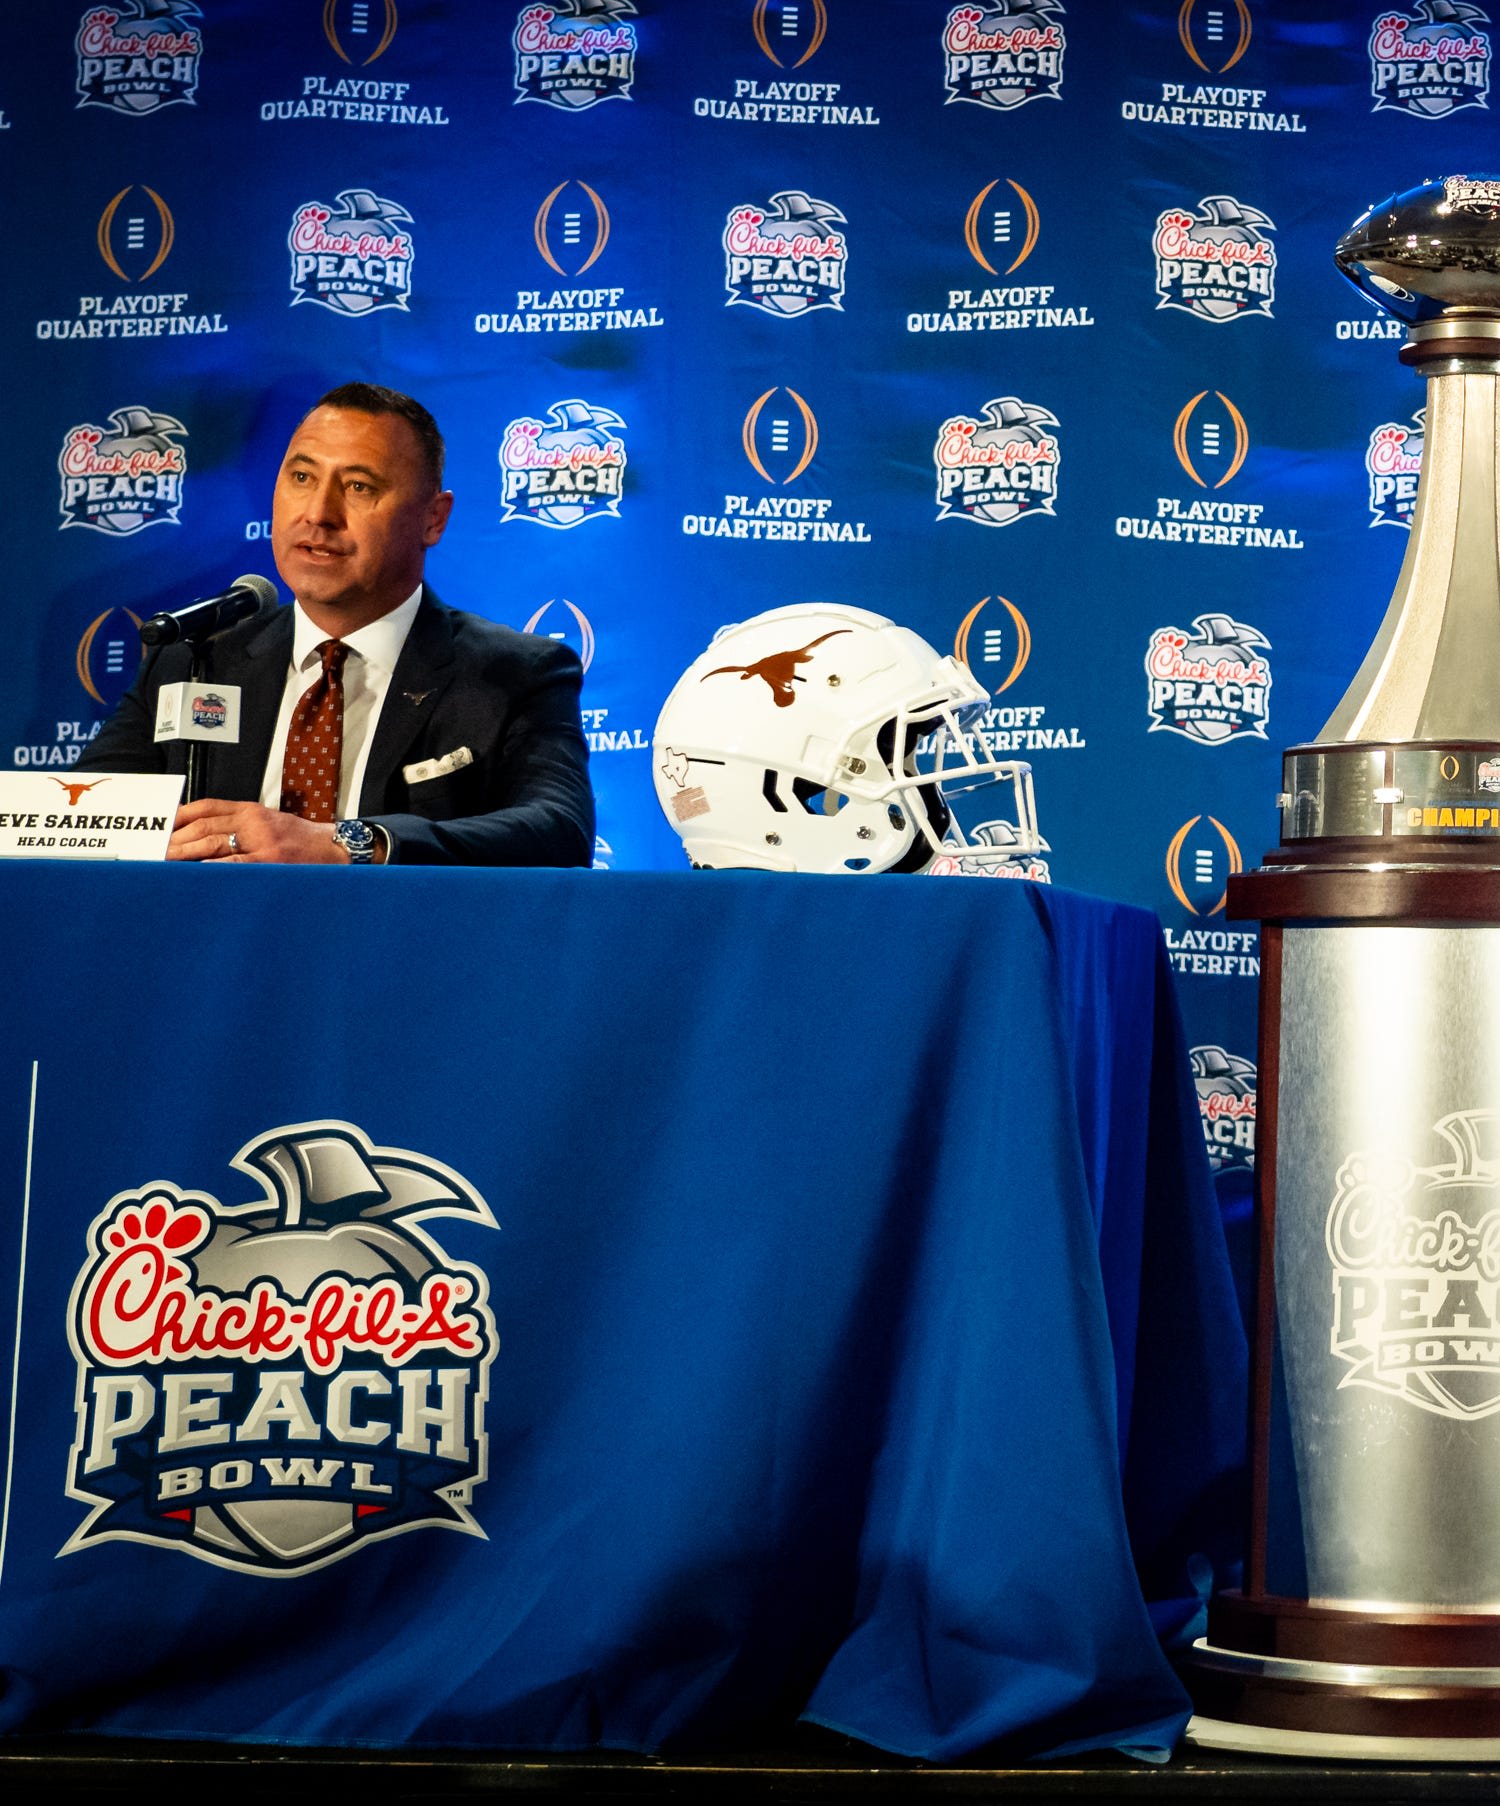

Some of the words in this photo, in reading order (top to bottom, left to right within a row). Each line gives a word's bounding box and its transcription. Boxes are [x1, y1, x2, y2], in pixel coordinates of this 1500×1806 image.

[82, 23, 195, 57] Chick-fil-A
[519, 20, 630, 53] Chick-fil-A
[949, 20, 1058, 52] Chick-fil-A
[1375, 28, 1484, 62] Chick-fil-A
[82, 57, 195, 86] PEACH
[520, 53, 630, 82] PEACH
[950, 51, 1058, 82] PEACH
[1377, 61, 1485, 90] PEACH
[103, 82, 171, 94] BOWL
[303, 77, 410, 101] PLAYOFF
[541, 79, 607, 90] BOWL
[735, 80, 840, 102] PLAYOFF
[971, 78, 1036, 89] BOWL
[1162, 84, 1266, 108] PLAYOFF
[1398, 87, 1463, 97] BOWL
[261, 97, 449, 126] QUARTERFINAL
[694, 99, 879, 126] QUARTERFINAL
[1122, 102, 1306, 134] QUARTERFINAL
[295, 219, 407, 258] Chick-fil-A
[730, 222, 840, 260] Chick-fil-A
[1159, 225, 1269, 265] Chick-fil-A
[296, 254, 406, 289] PEACH
[731, 257, 840, 289] PEACH
[1161, 260, 1269, 295] PEACH
[317, 283, 384, 296] BOWL
[517, 289, 624, 310] PLAYOFF
[752, 284, 818, 296] BOWL
[948, 286, 1054, 308] PLAYOFF
[1182, 289, 1248, 302] BOWL
[79, 294, 188, 316] PLAYOFF
[37, 315, 228, 339] QUARTERFINAL
[476, 310, 664, 333] QUARTERFINAL
[907, 308, 1094, 332] QUARTERFINAL
[66, 442, 179, 476] Chick-fil-A
[507, 435, 618, 469] Chick-fil-A
[941, 433, 1052, 467] Chick-fil-A
[66, 475, 178, 506] PEACH
[507, 468, 618, 499] PEACH
[942, 465, 1052, 497] PEACH
[87, 502, 155, 514] BOWL
[528, 495, 595, 507] BOWL
[725, 496, 831, 519] PLAYOFF
[963, 493, 1030, 504] BOWL
[1157, 499, 1263, 524] PLAYOFF
[683, 516, 871, 543] QUARTERFINAL
[1116, 518, 1303, 550] QUARTERFINAL
[1152, 645, 1264, 685] Chick-fil-A
[1154, 681, 1264, 716] PEACH
[1175, 710, 1242, 723] BOWL
[0, 813, 39, 828] EVE
[44, 814, 167, 831] SARKISIAN
[17, 837, 56, 847] HEAD
[59, 838, 107, 848] COACH
[1163, 928, 1257, 952] LAYOFF
[90, 1243, 475, 1367] Chick-fil-A
[85, 1369, 470, 1475] PEACH
[158, 1458, 392, 1500] BOWL
